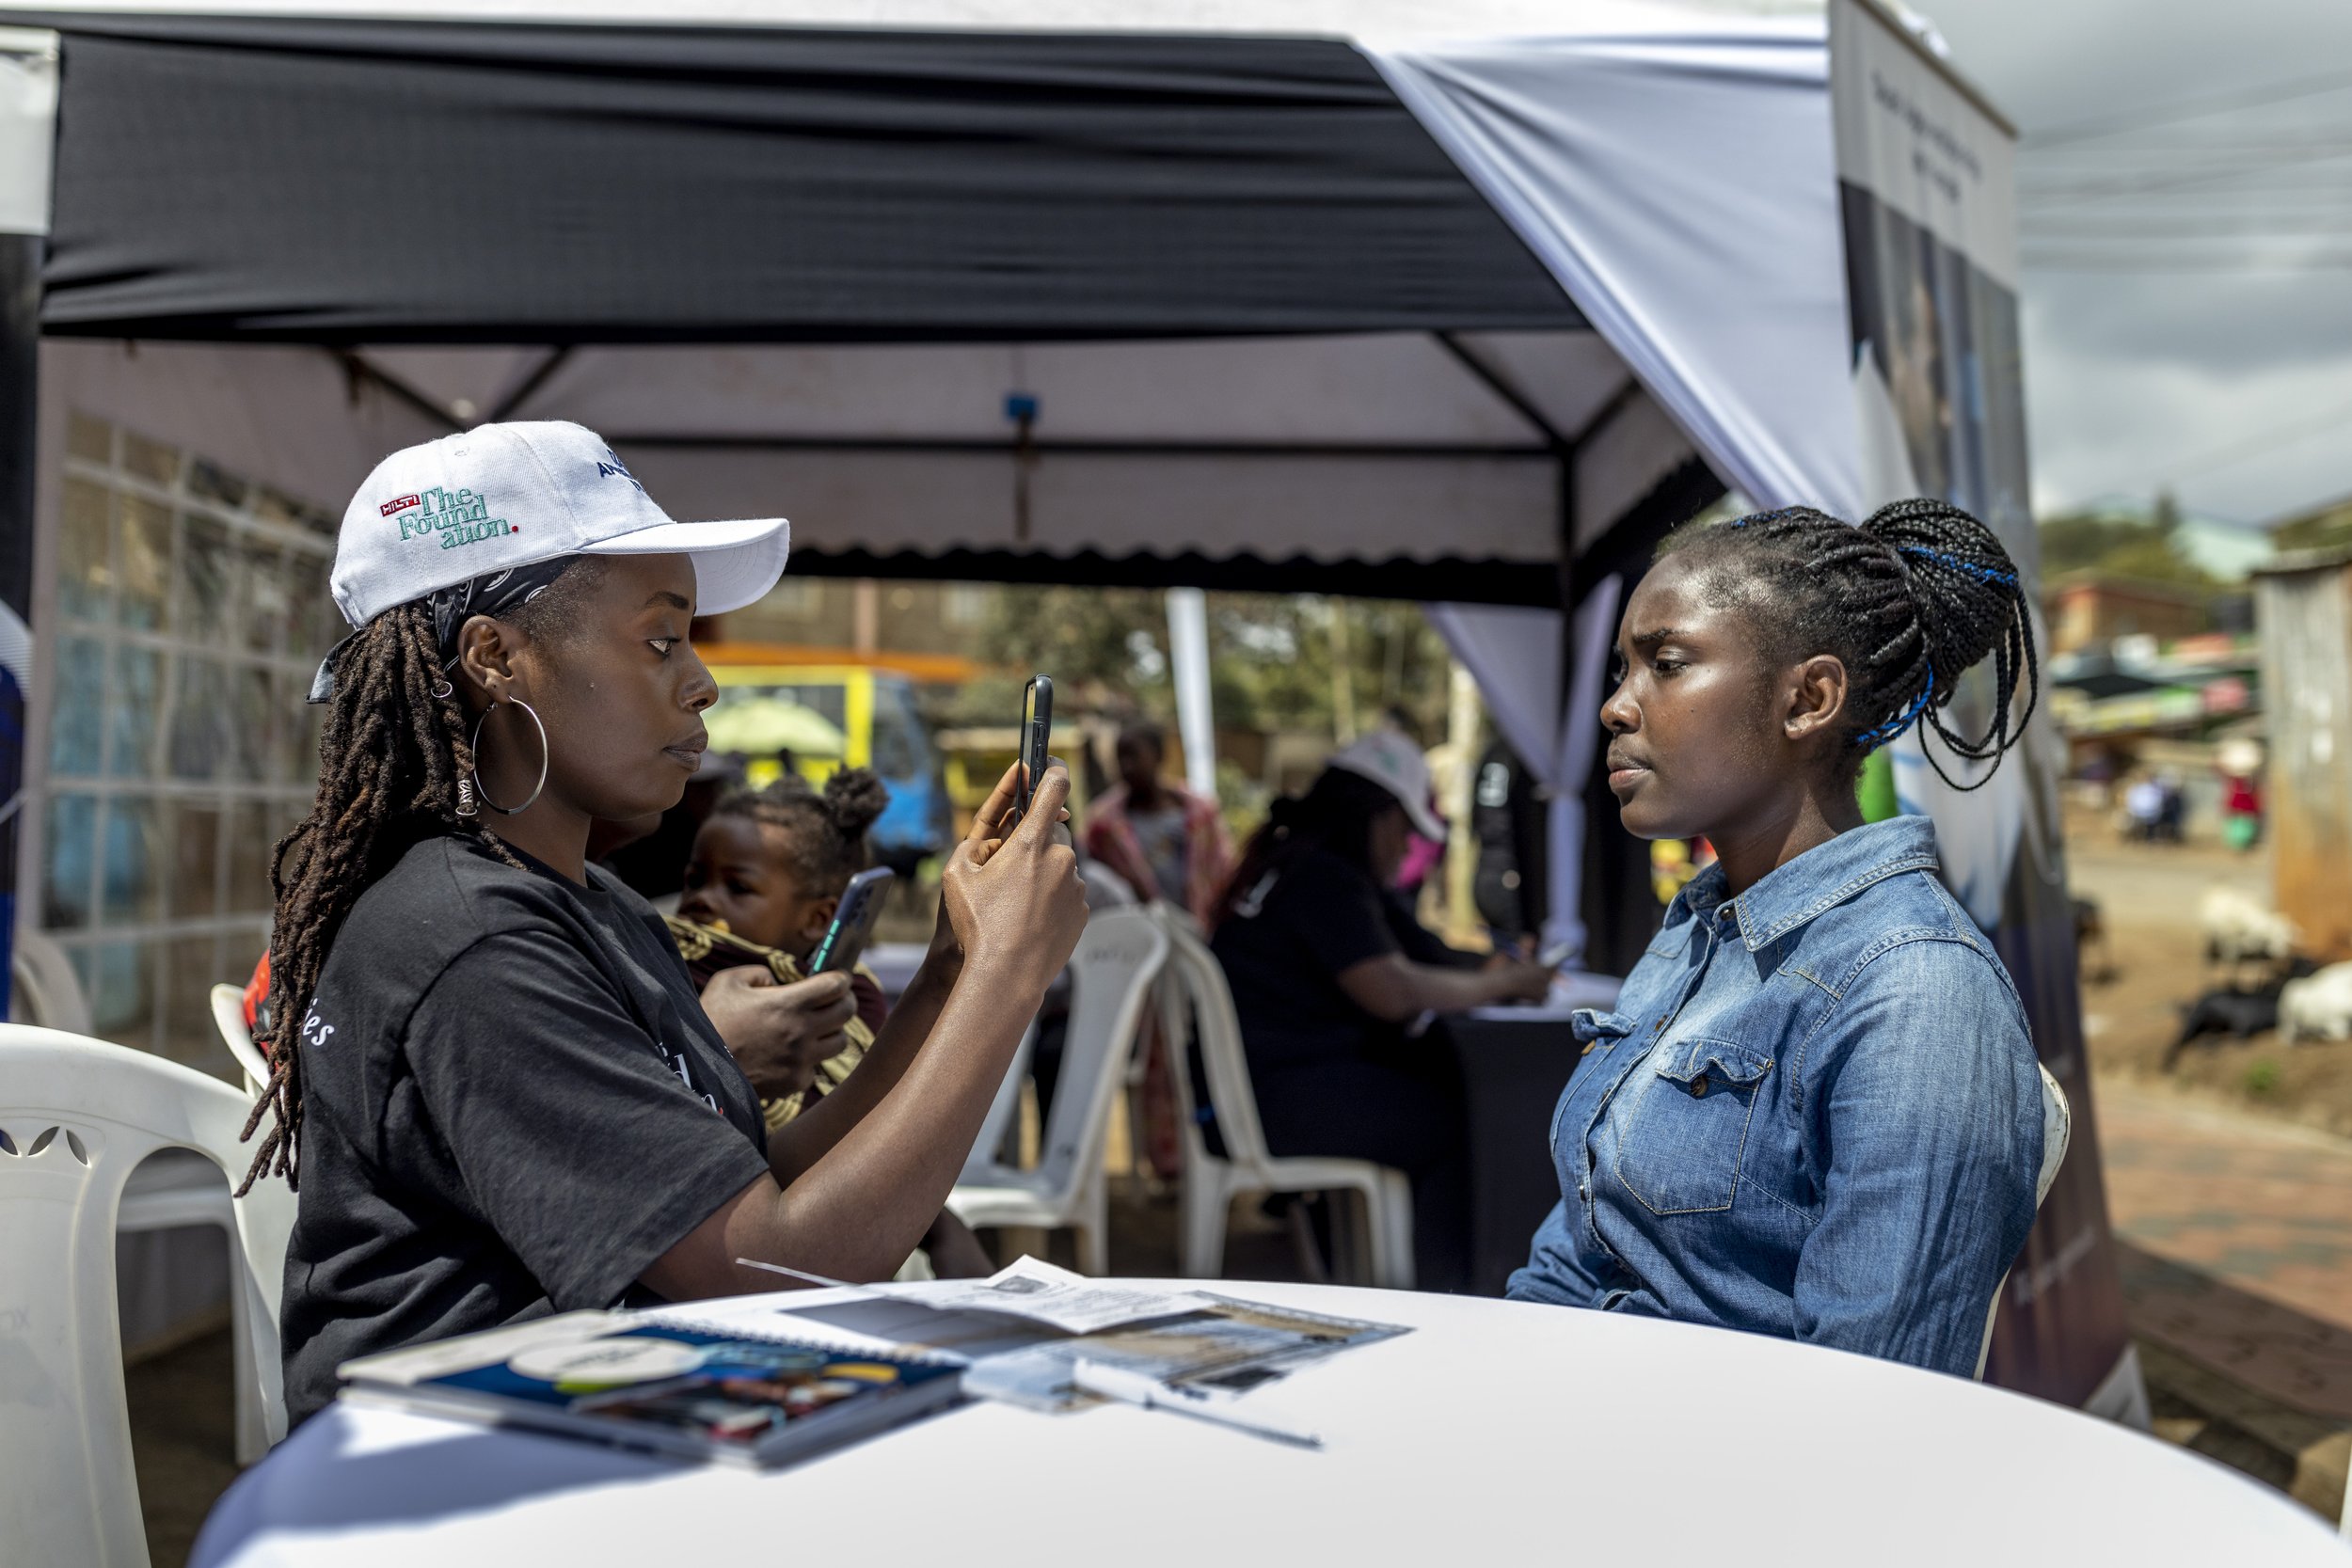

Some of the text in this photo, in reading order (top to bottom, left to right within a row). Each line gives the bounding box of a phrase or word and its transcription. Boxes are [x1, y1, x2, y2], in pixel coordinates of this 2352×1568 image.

[381, 485, 473, 516] HILTI The
[396, 494, 489, 542] Found
[440, 518, 519, 549] ation.
